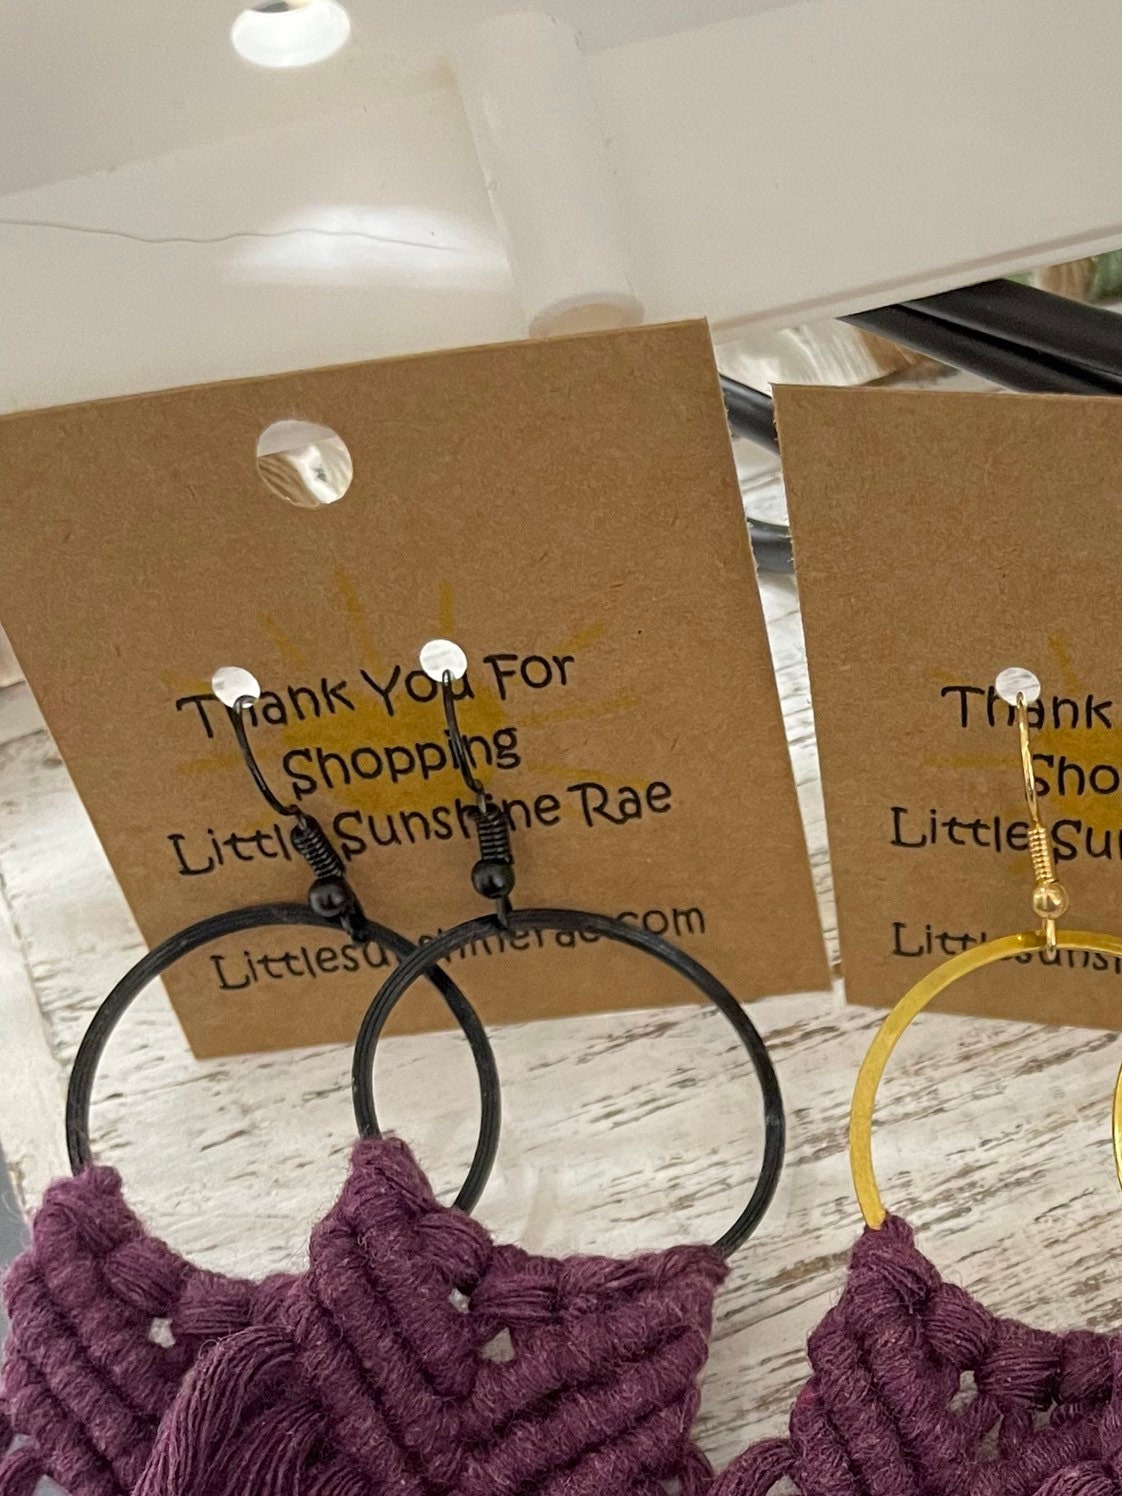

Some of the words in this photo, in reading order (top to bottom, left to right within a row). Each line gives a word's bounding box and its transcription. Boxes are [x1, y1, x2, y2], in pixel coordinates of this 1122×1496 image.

[483, 653, 574, 700] For
[941, 686, 1112, 729] Thank
[167, 823, 304, 876] Littl
[332, 793, 561, 862] Sunshne
[567, 781, 672, 827] Rae
[891, 806, 1029, 853] Little
